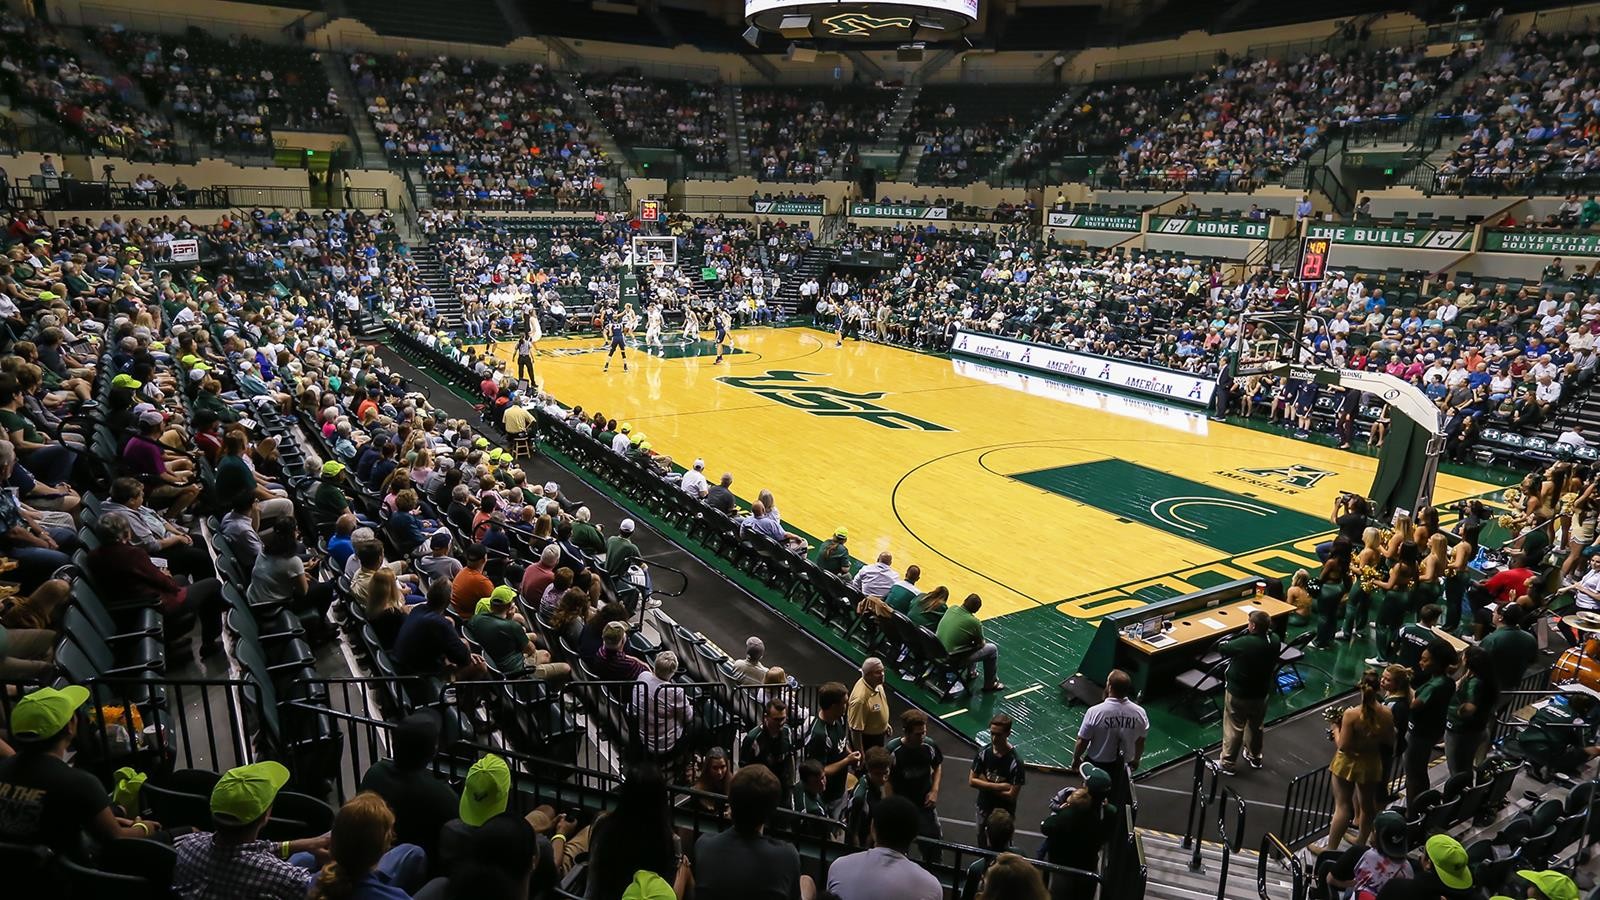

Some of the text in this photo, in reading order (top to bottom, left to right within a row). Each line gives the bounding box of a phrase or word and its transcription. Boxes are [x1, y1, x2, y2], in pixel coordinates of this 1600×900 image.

[643, 208, 655, 218] 23
[854, 207, 917, 216] GO BULLS!
[1197, 222, 1266, 236] HOME OF
[1313, 228, 1416, 244] THE BULLS
[1503, 235, 1589, 245] UNIVERSITY
[1502, 242, 1544, 250] SOUTH
[1303, 255, 1322, 276] 23
[975, 345, 1011, 359] AMERICAN
[1046, 360, 1088, 376] AMERICAN
[1125, 376, 1173, 394] AMERICAN
[1289, 369, 1317, 379] Frontier
[1213, 470, 1300, 496] AMERICAN
[1104, 716, 1138, 729] SENTRY
[12, 785, 47, 801] THE
